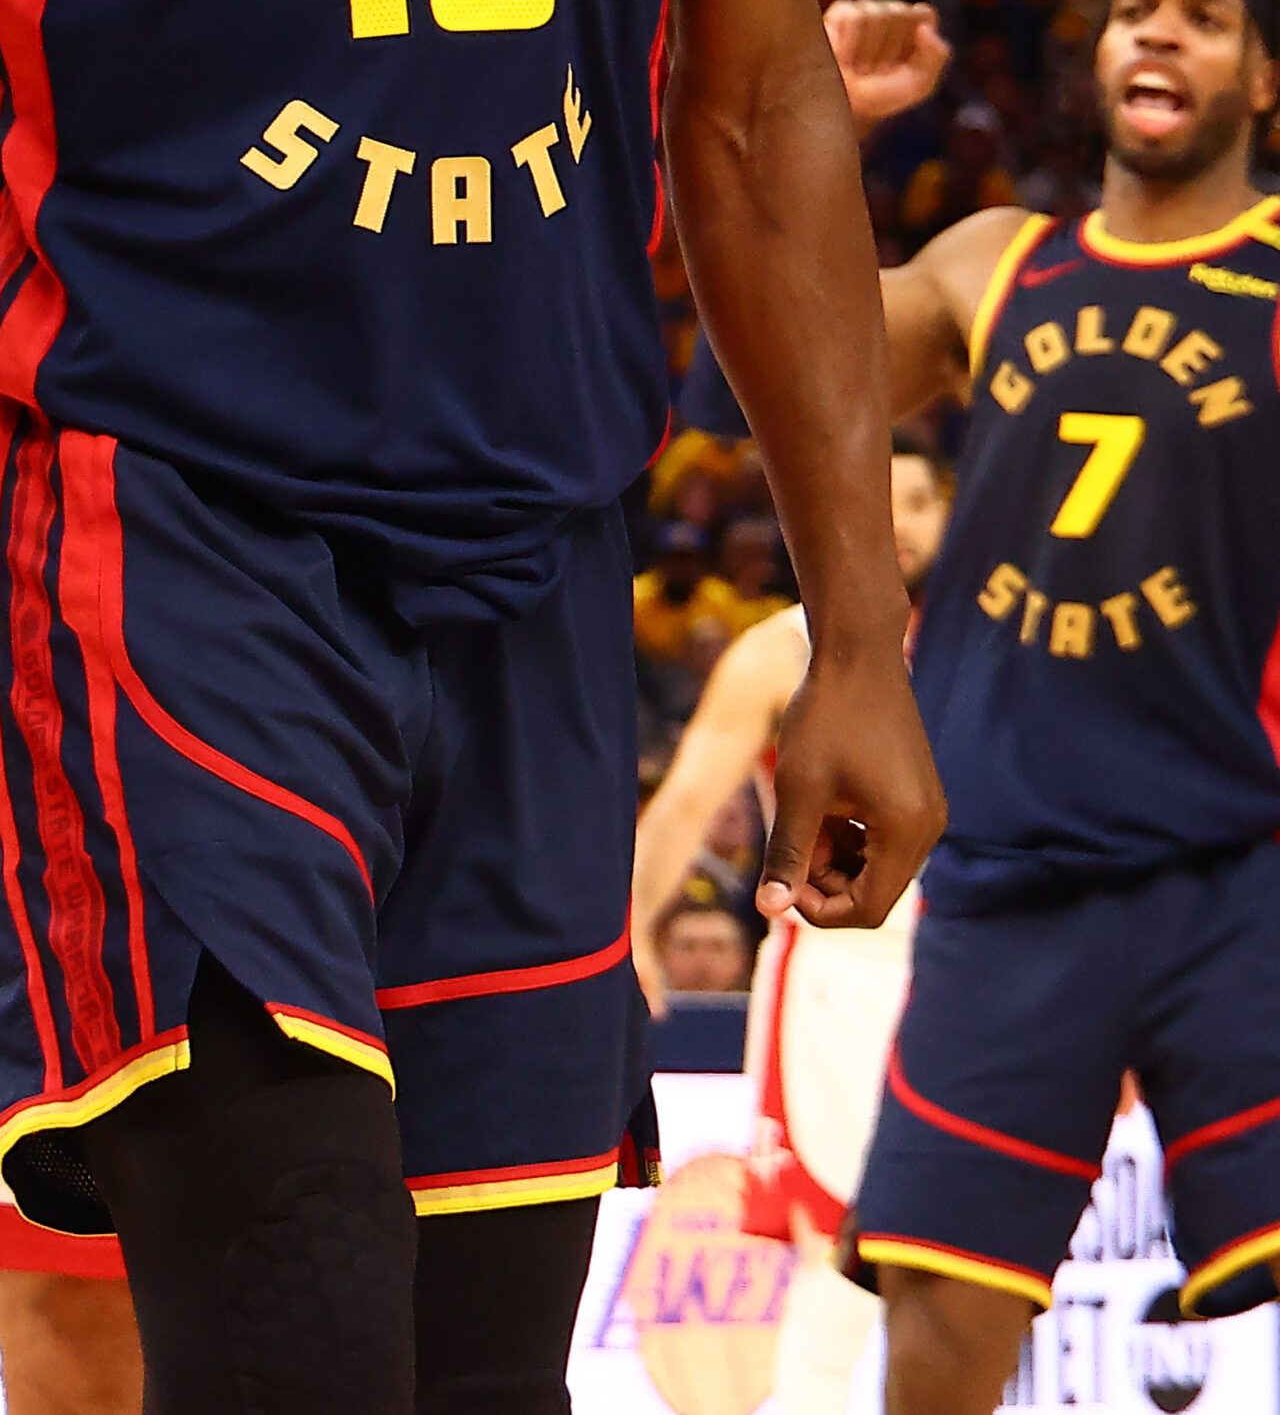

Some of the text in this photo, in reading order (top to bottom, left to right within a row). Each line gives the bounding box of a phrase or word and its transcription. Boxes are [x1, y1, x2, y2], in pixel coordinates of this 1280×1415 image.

[239, 63, 592, 245] STATE
[988, 303, 1253, 428] GOLDEN
[1050, 411, 1146, 539] 7
[976, 561, 1198, 660] STATE
